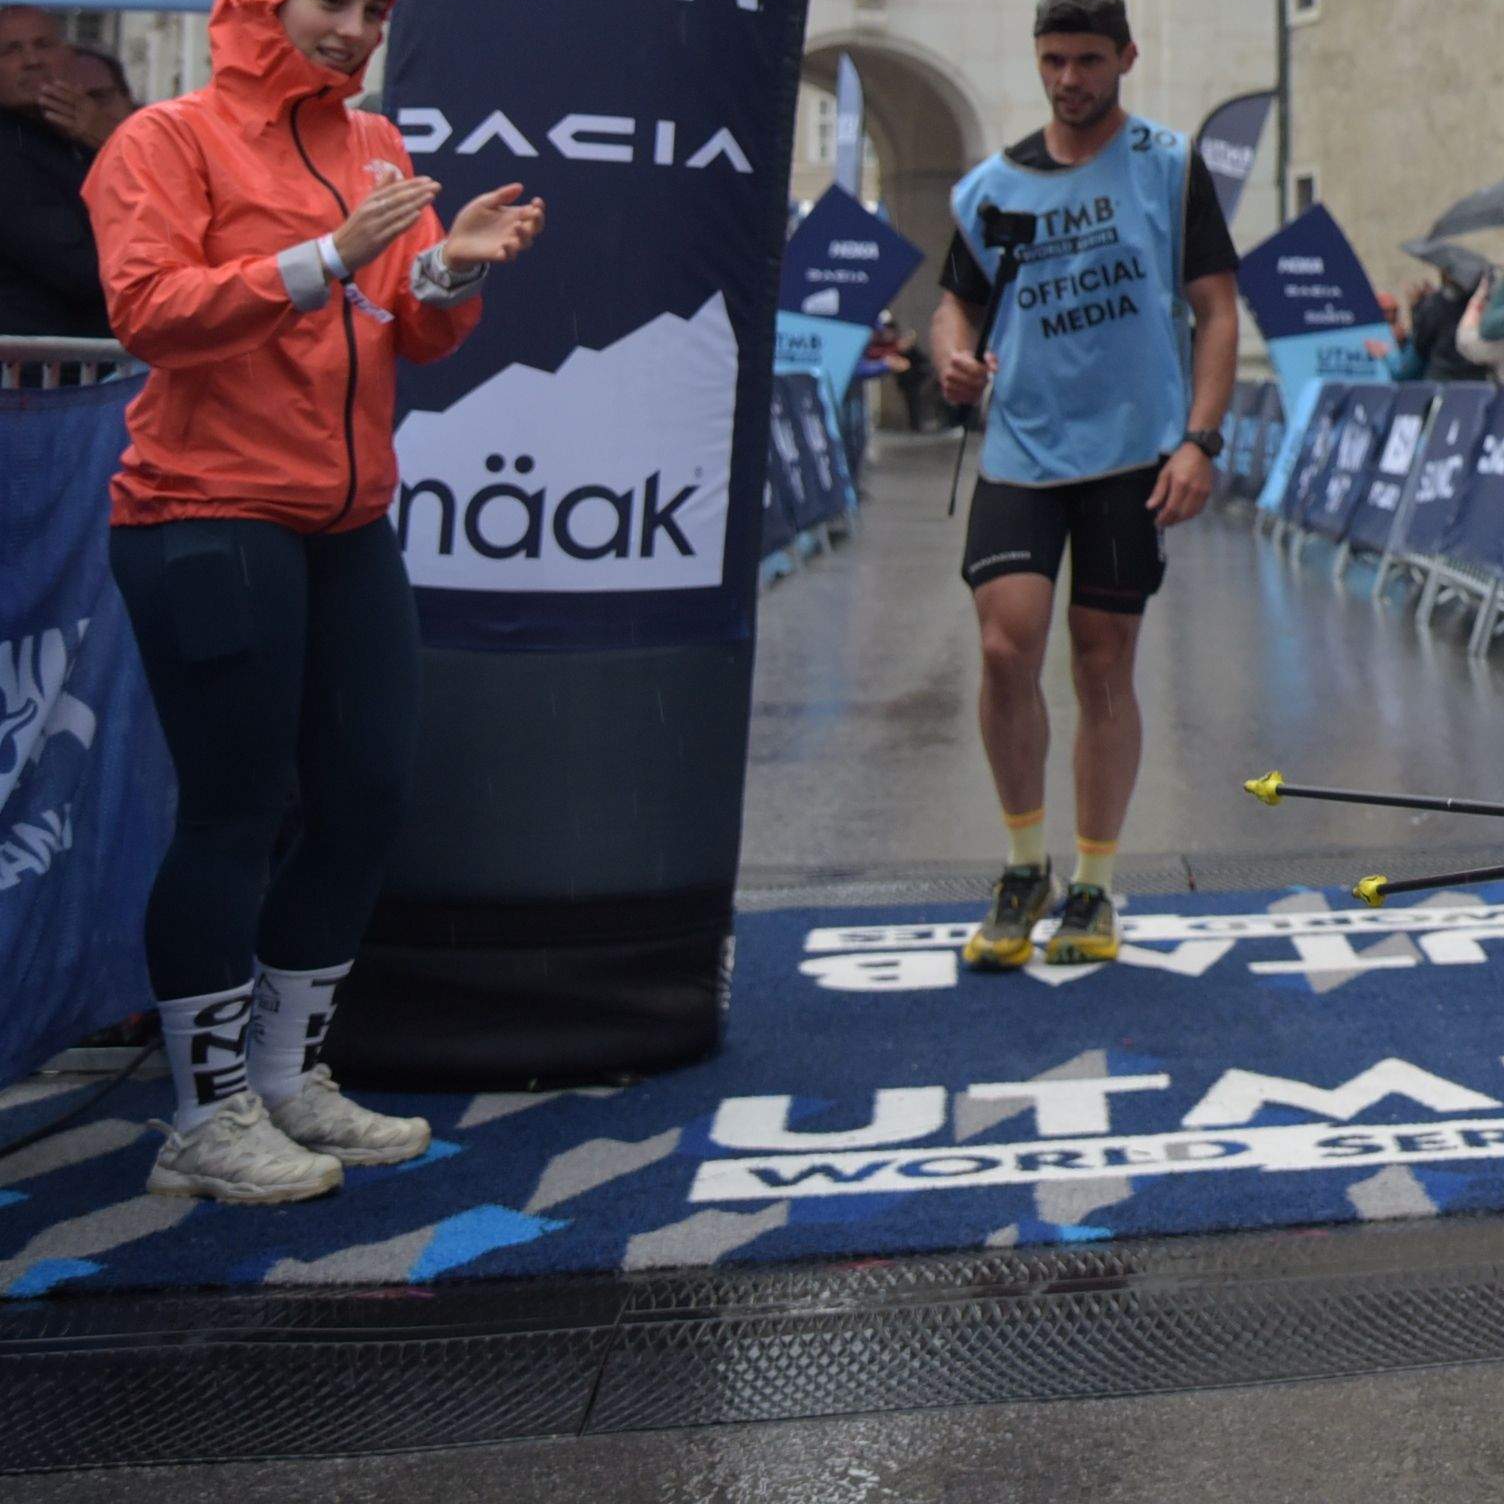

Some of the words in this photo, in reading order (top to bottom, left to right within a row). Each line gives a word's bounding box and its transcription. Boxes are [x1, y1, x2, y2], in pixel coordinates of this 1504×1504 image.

[396, 107, 755, 174] DACIA
[1018, 255, 1148, 311] OFFICIAL
[1040, 293, 1139, 339] MEDIA
[397, 453, 702, 561] näak
[747, 1136, 1252, 1188] WORLD
